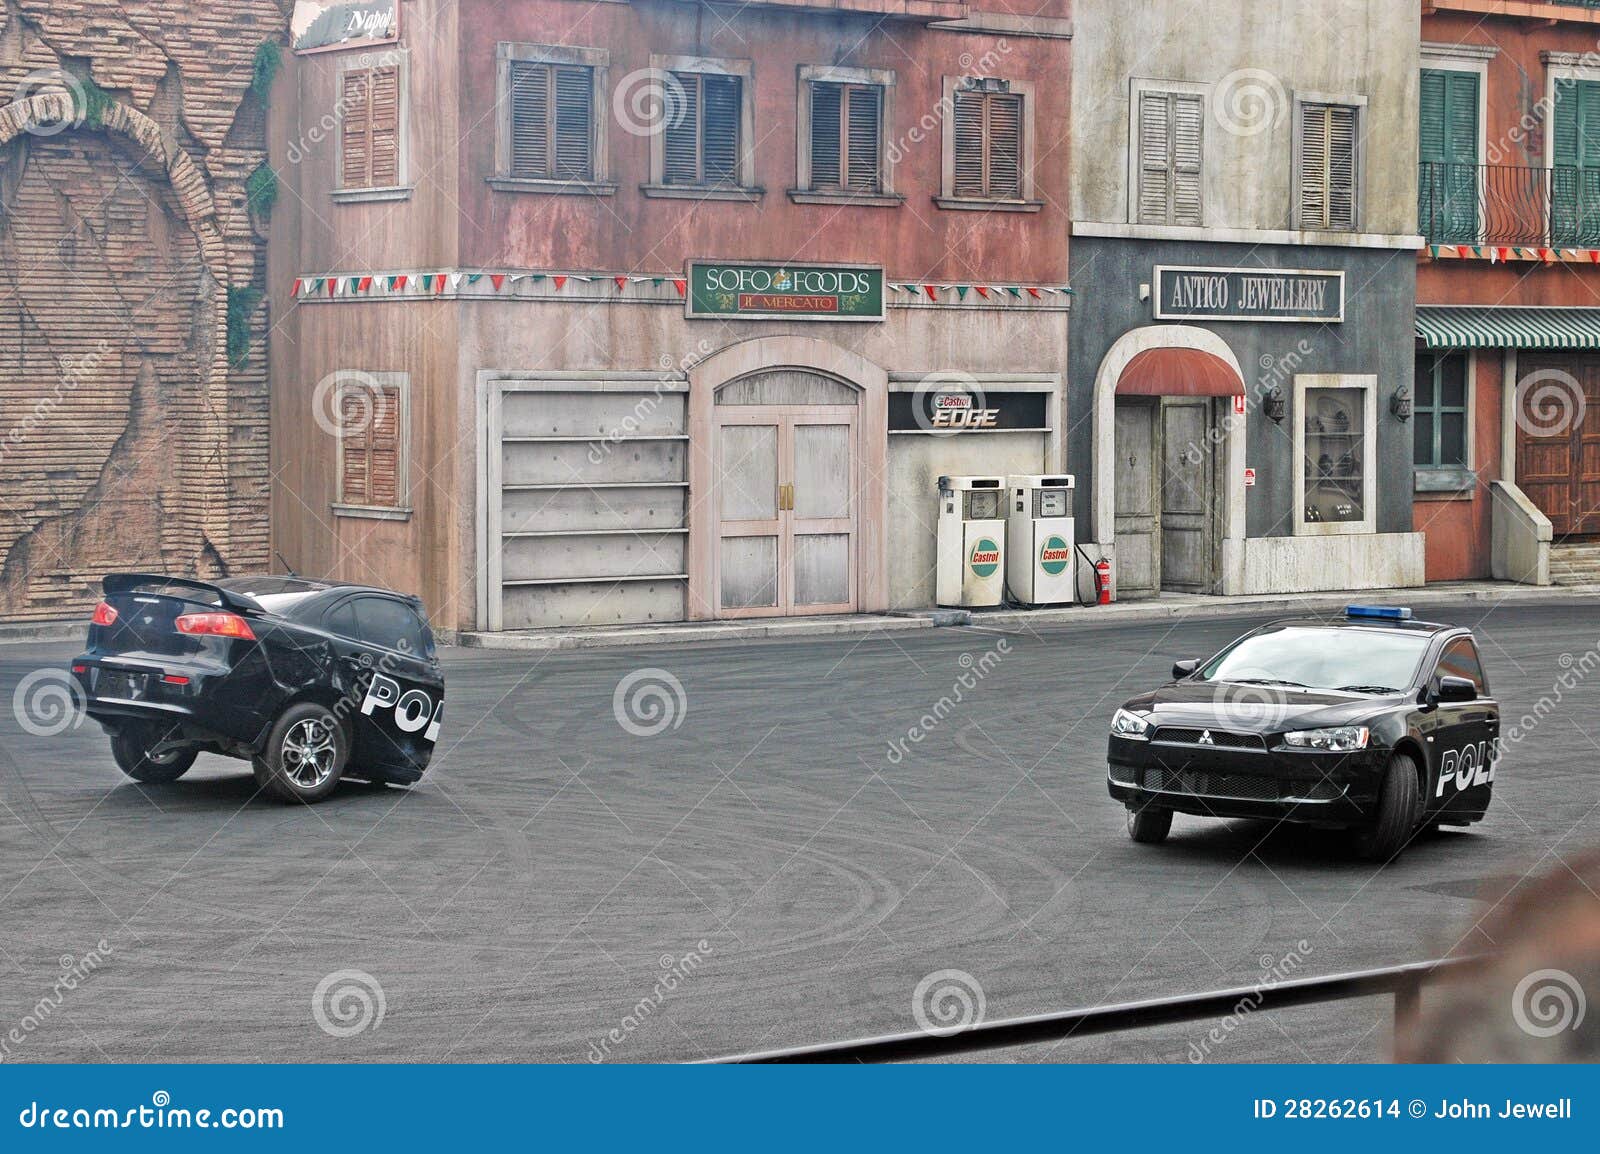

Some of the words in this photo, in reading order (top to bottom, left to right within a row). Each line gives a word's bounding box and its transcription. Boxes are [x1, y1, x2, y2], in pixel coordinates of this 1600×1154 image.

[705, 268, 772, 291] SOFO
[793, 271, 870, 294] FOODS
[1171, 275, 1229, 309] ANTICO
[1238, 277, 1328, 311] JEWELLERY
[743, 296, 757, 307] IL
[763, 297, 832, 309] MERCATO
[944, 396, 970, 407] Castrol
[931, 408, 1000, 427] EDGE
[973, 552, 999, 563] Castrol
[1043, 549, 1068, 560] Castrol
